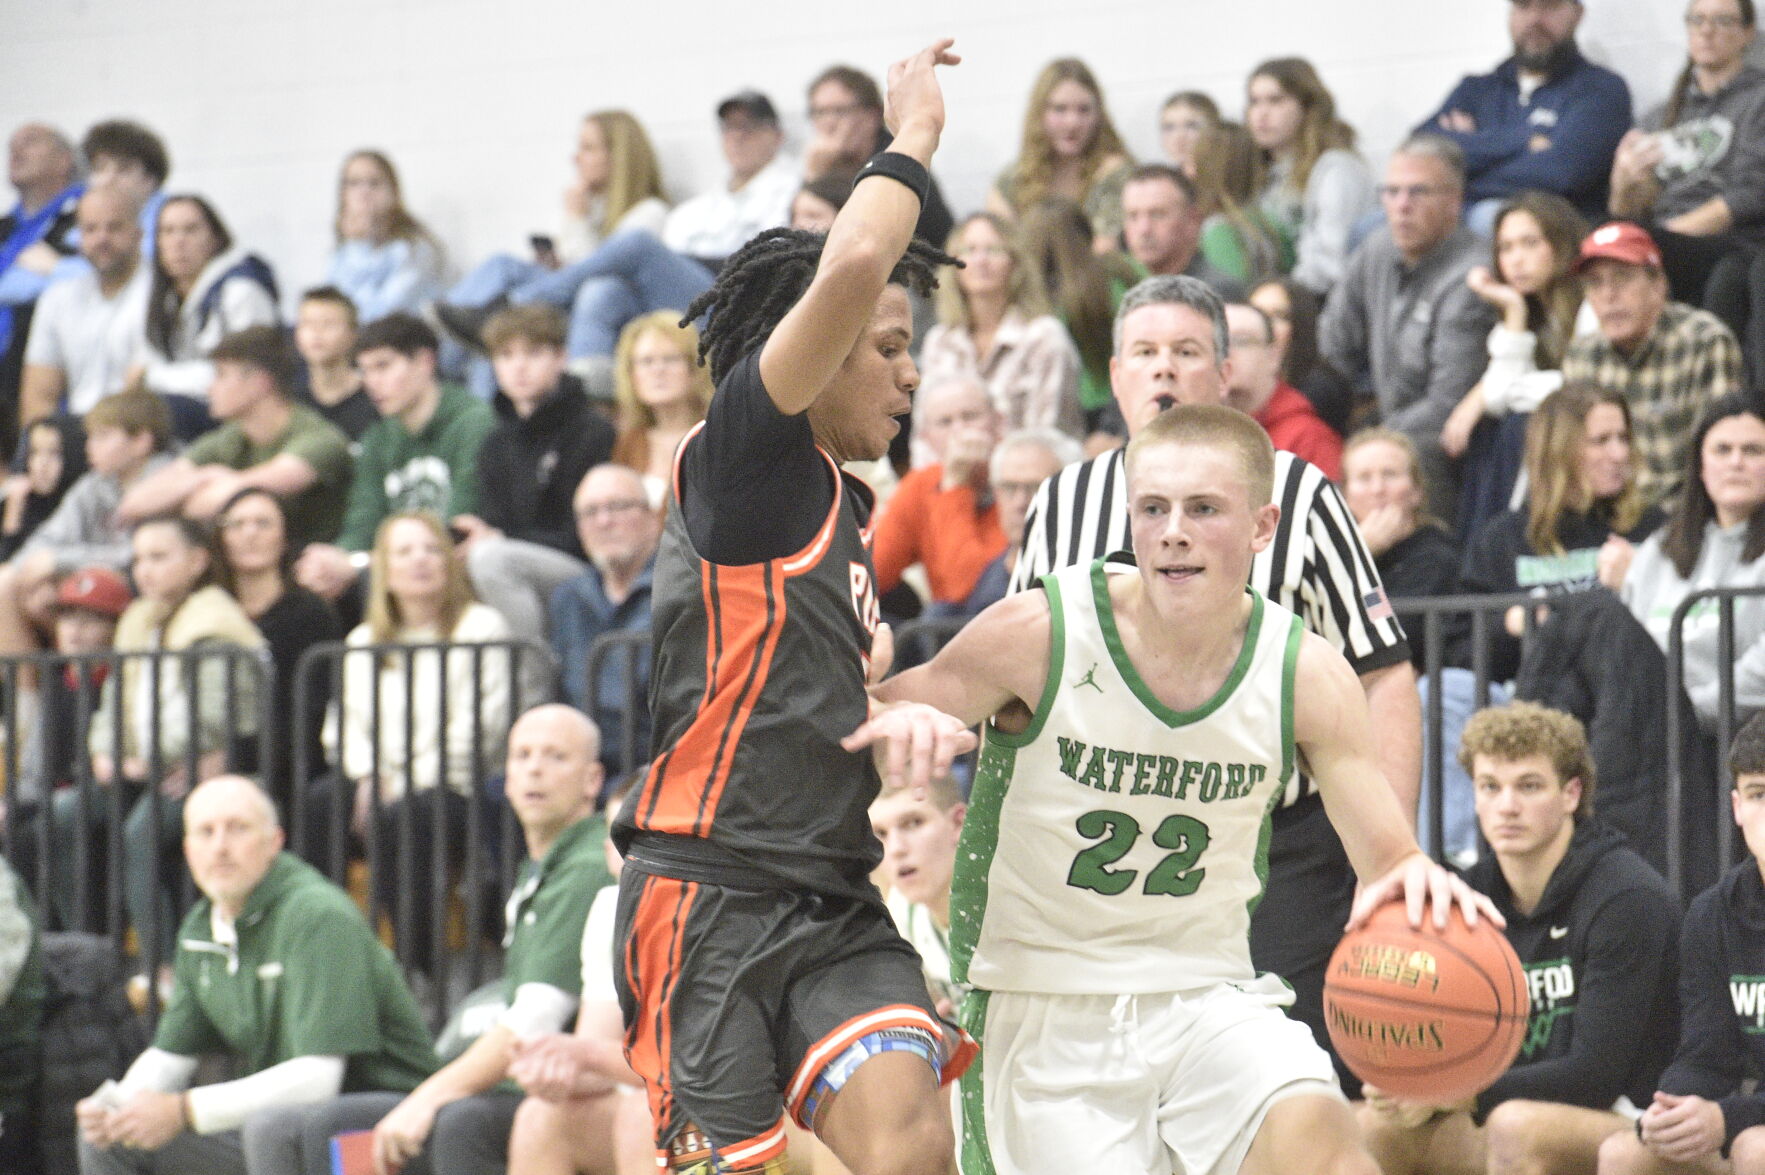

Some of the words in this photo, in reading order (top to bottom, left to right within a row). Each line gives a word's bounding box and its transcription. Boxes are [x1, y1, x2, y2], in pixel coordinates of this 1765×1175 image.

[1057, 736, 1267, 803] WATERFORD
[1066, 809, 1212, 897] 22
[1328, 999, 1445, 1050] SPALDING
